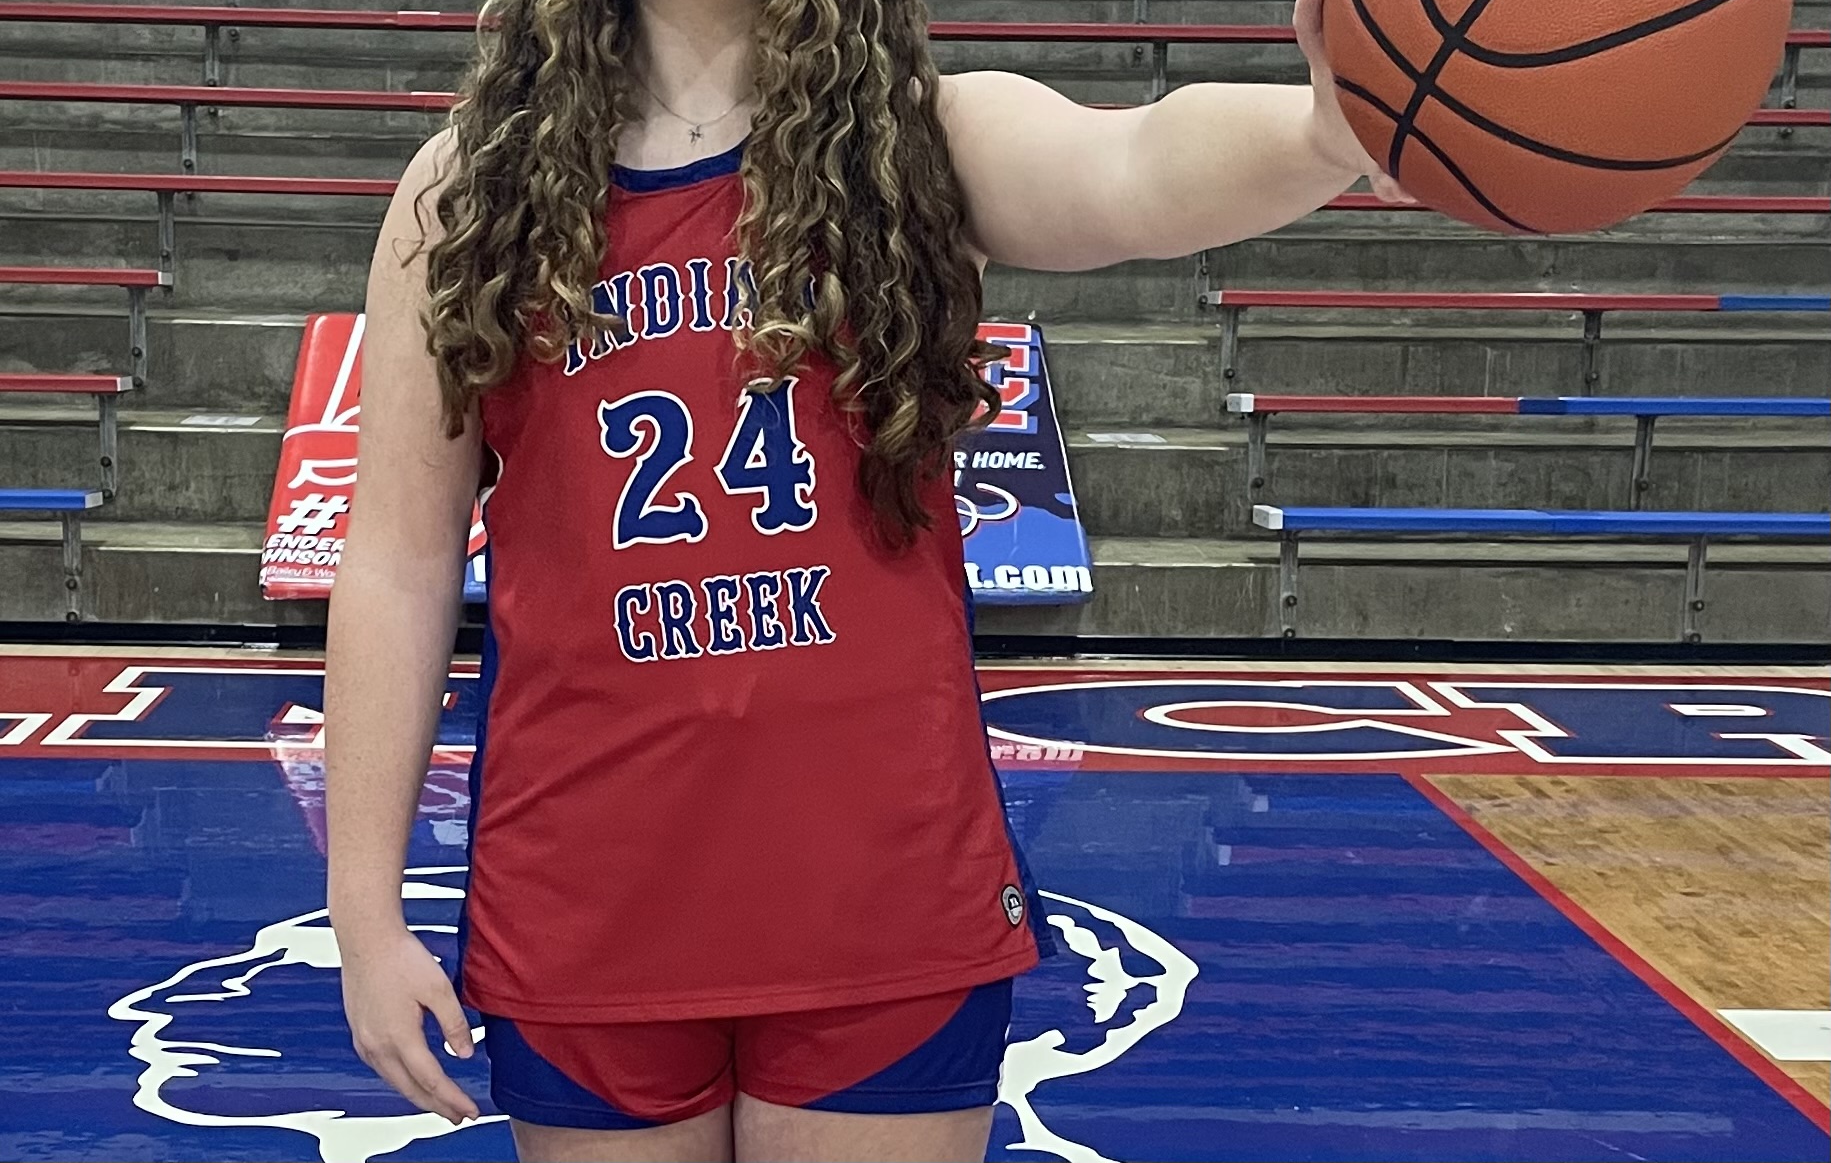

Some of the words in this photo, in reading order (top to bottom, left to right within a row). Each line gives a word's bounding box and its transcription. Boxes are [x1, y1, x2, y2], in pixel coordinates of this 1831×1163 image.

[596, 377, 818, 550] 24
[972, 451, 1046, 470] HOME.
[613, 565, 836, 663] CREEK
